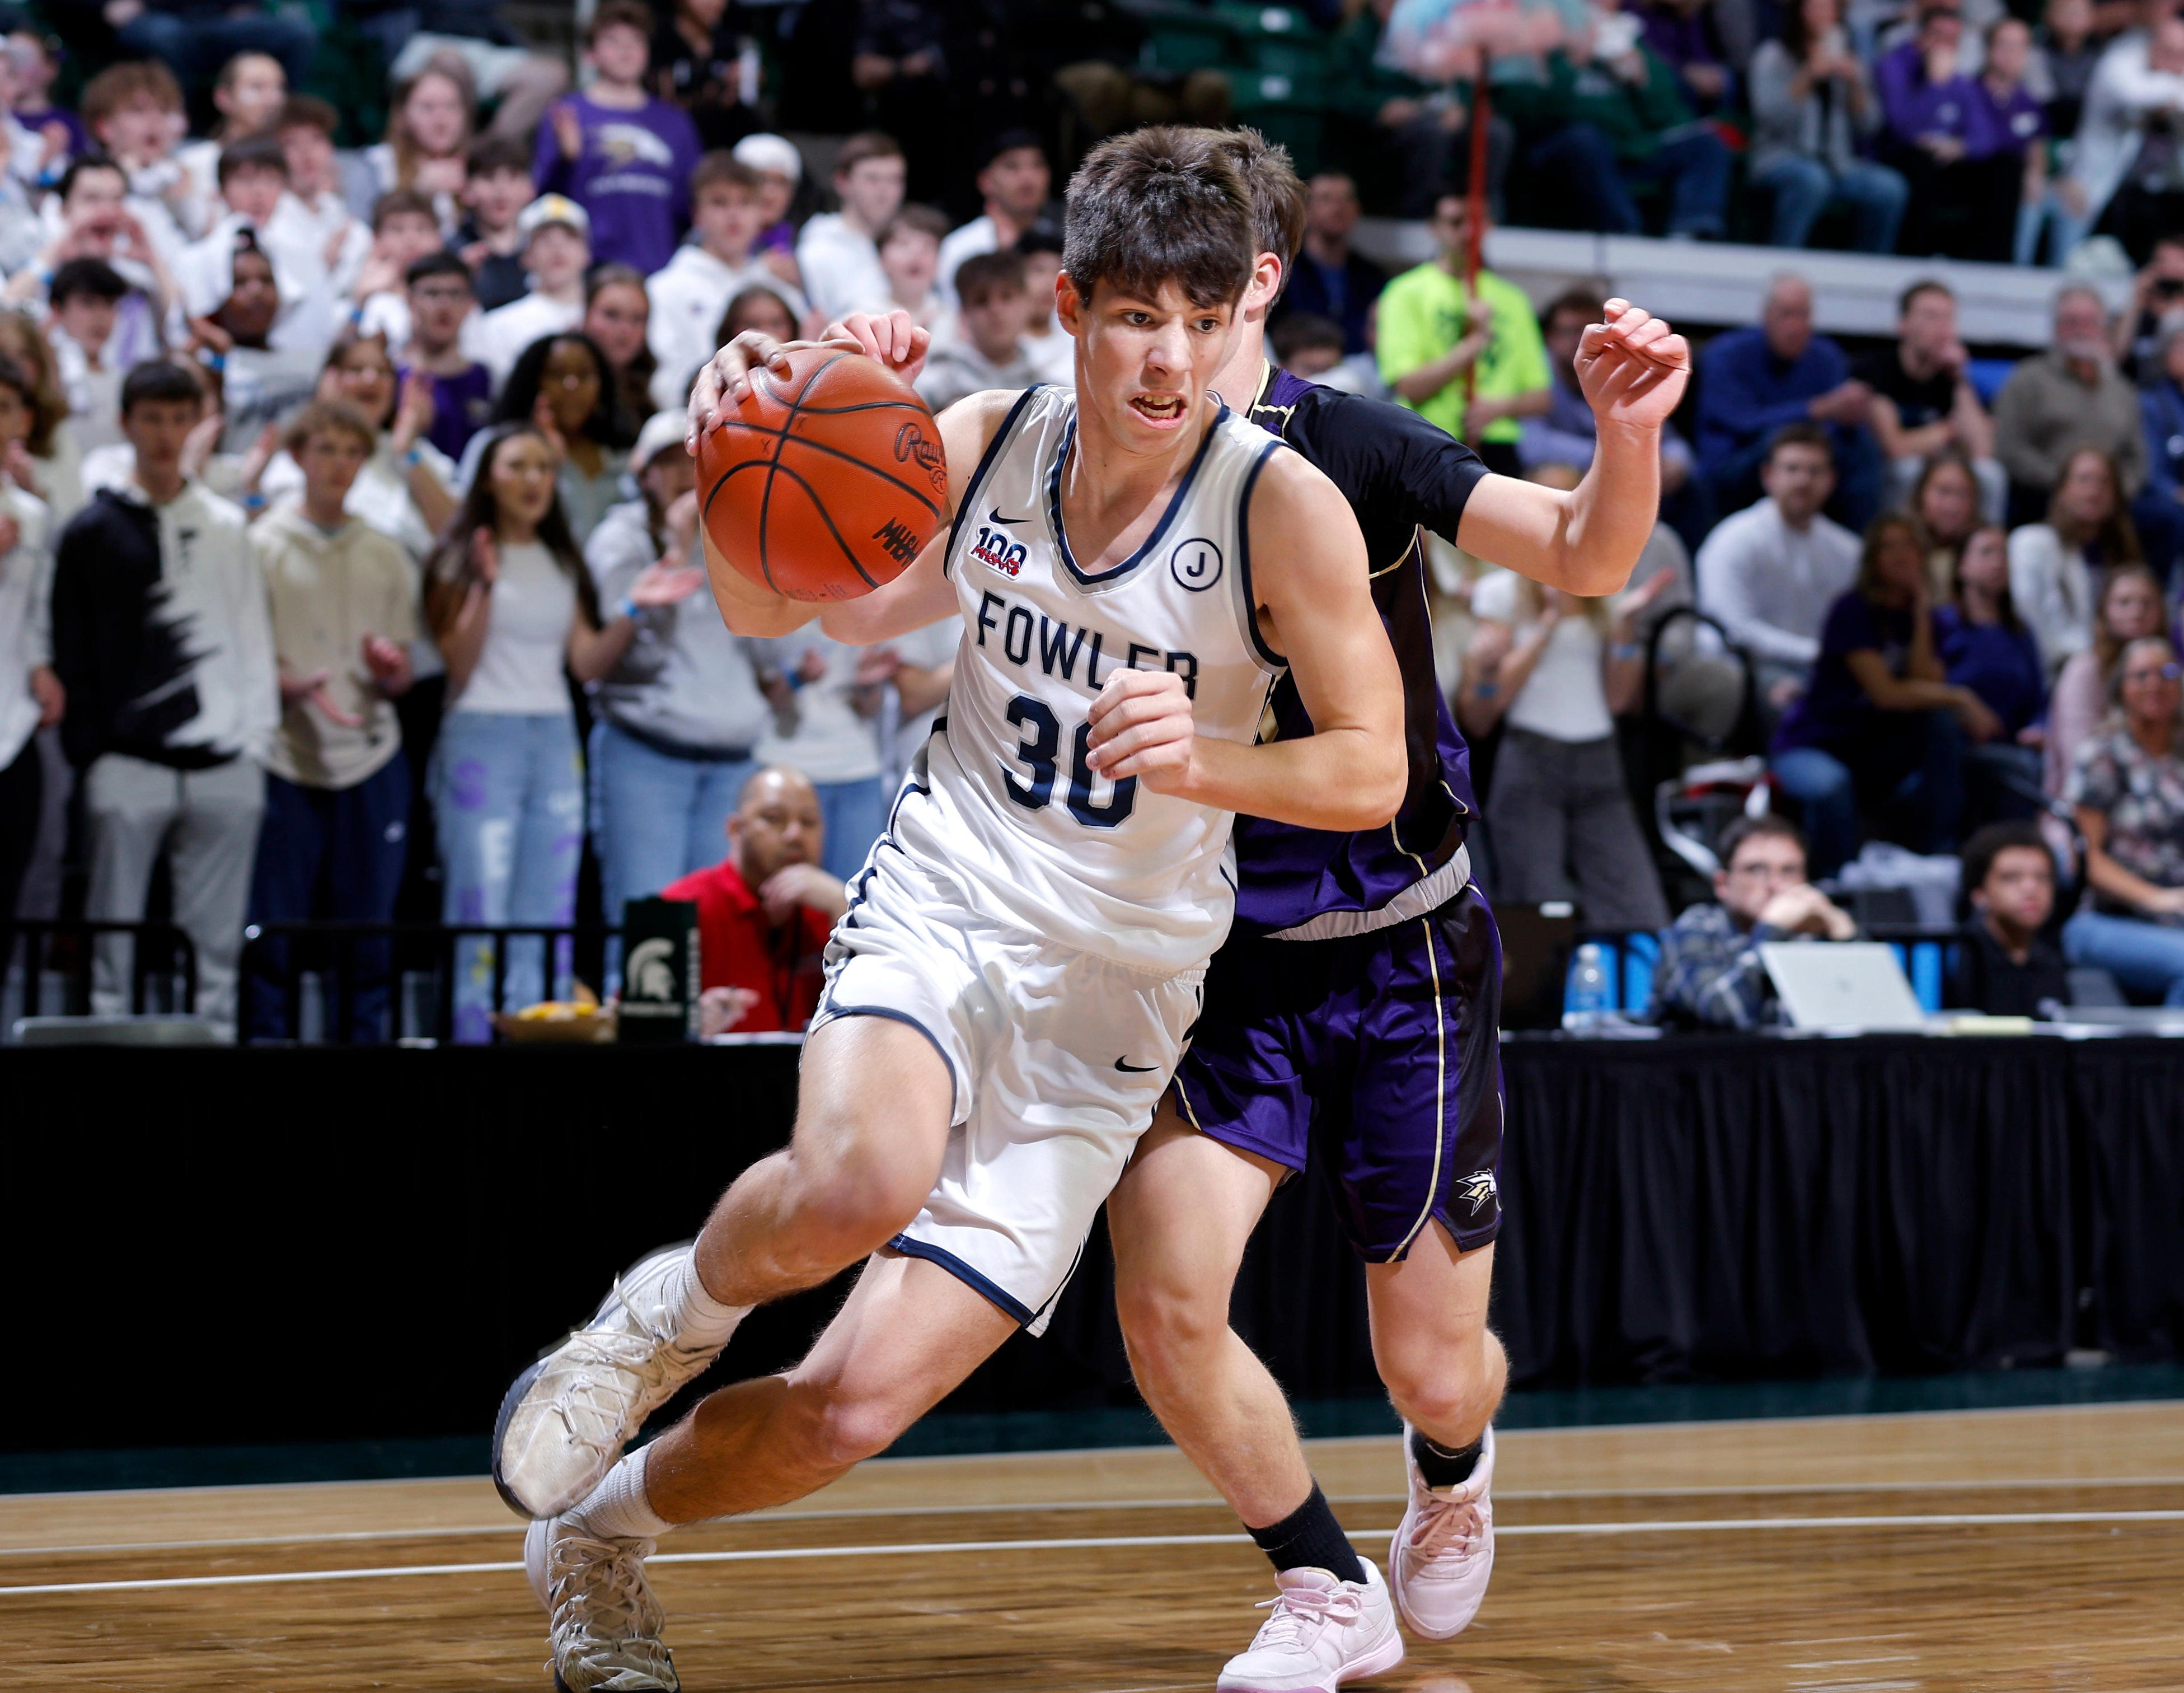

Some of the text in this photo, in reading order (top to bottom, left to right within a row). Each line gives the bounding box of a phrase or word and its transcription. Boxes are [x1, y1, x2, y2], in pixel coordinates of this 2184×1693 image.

[979, 527, 1028, 568] 100
[1186, 551, 1206, 577] J
[995, 692, 1142, 831] 30
